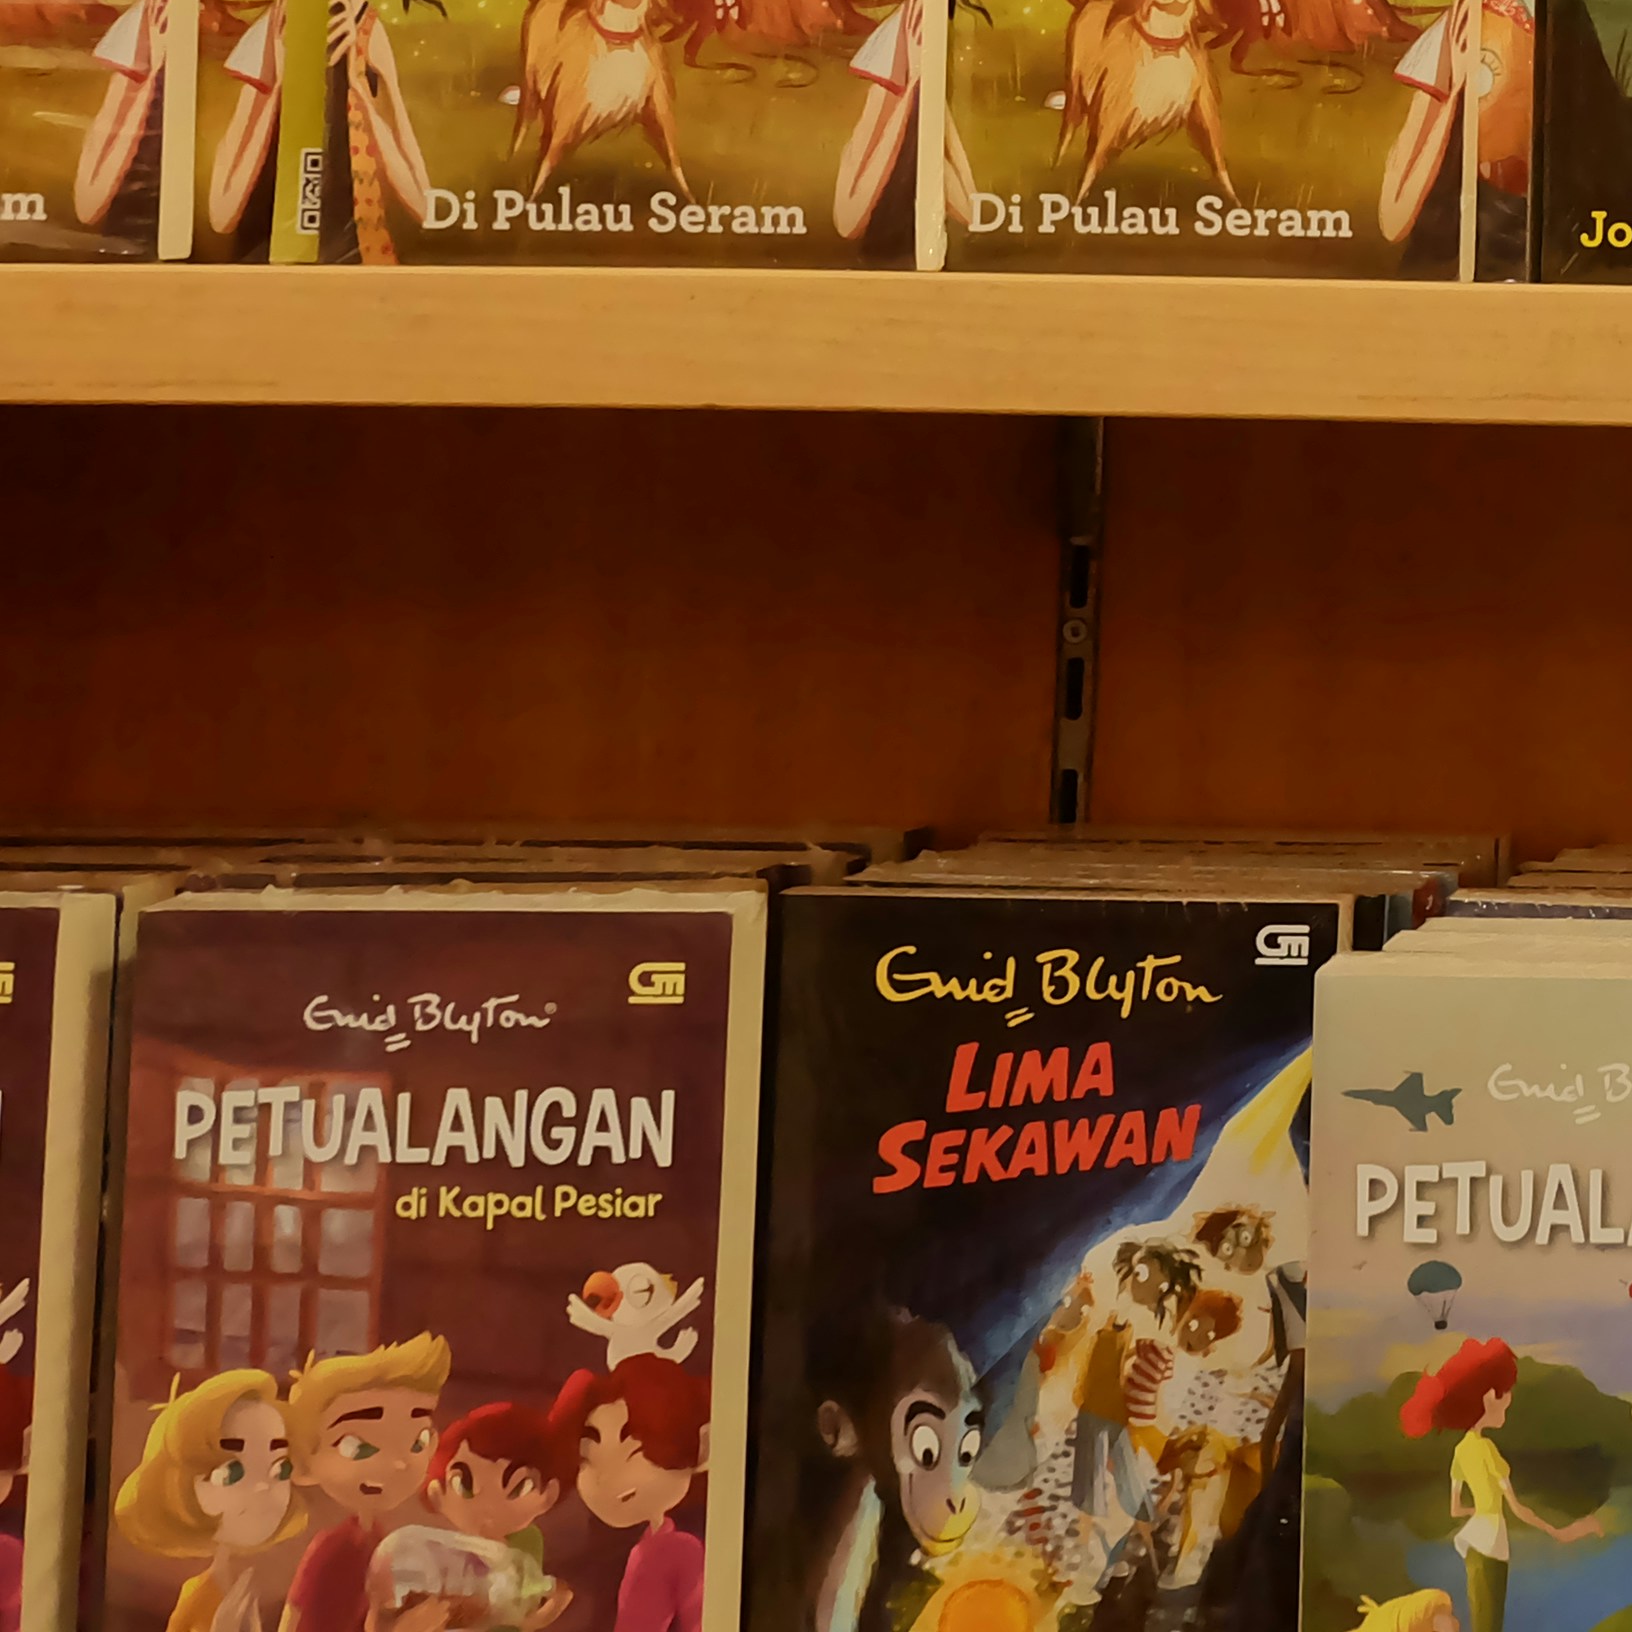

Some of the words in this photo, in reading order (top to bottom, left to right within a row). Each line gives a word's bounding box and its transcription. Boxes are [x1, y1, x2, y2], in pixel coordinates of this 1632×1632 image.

[423, 188, 478, 230] Di
[492, 186, 634, 233] Pulau
[648, 192, 807, 235] Seram
[968, 192, 1024, 233] Di
[1039, 190, 1179, 236] Pulau
[1194, 195, 1353, 239] Seram
[875, 945, 1016, 1003] Enid
[1035, 948, 1223, 1020] Blyton
[303, 994, 396, 1032] Enid
[945, 1041, 1114, 1114] LIMA
[1487, 1063, 1585, 1104] Enid
[174, 1086, 676, 1168] PETUALANGAN
[872, 1104, 1202, 1194] SEKAWAN
[395, 1188, 428, 1219] di
[438, 1185, 546, 1230] Kapal
[554, 1185, 663, 1218] Pesiar
